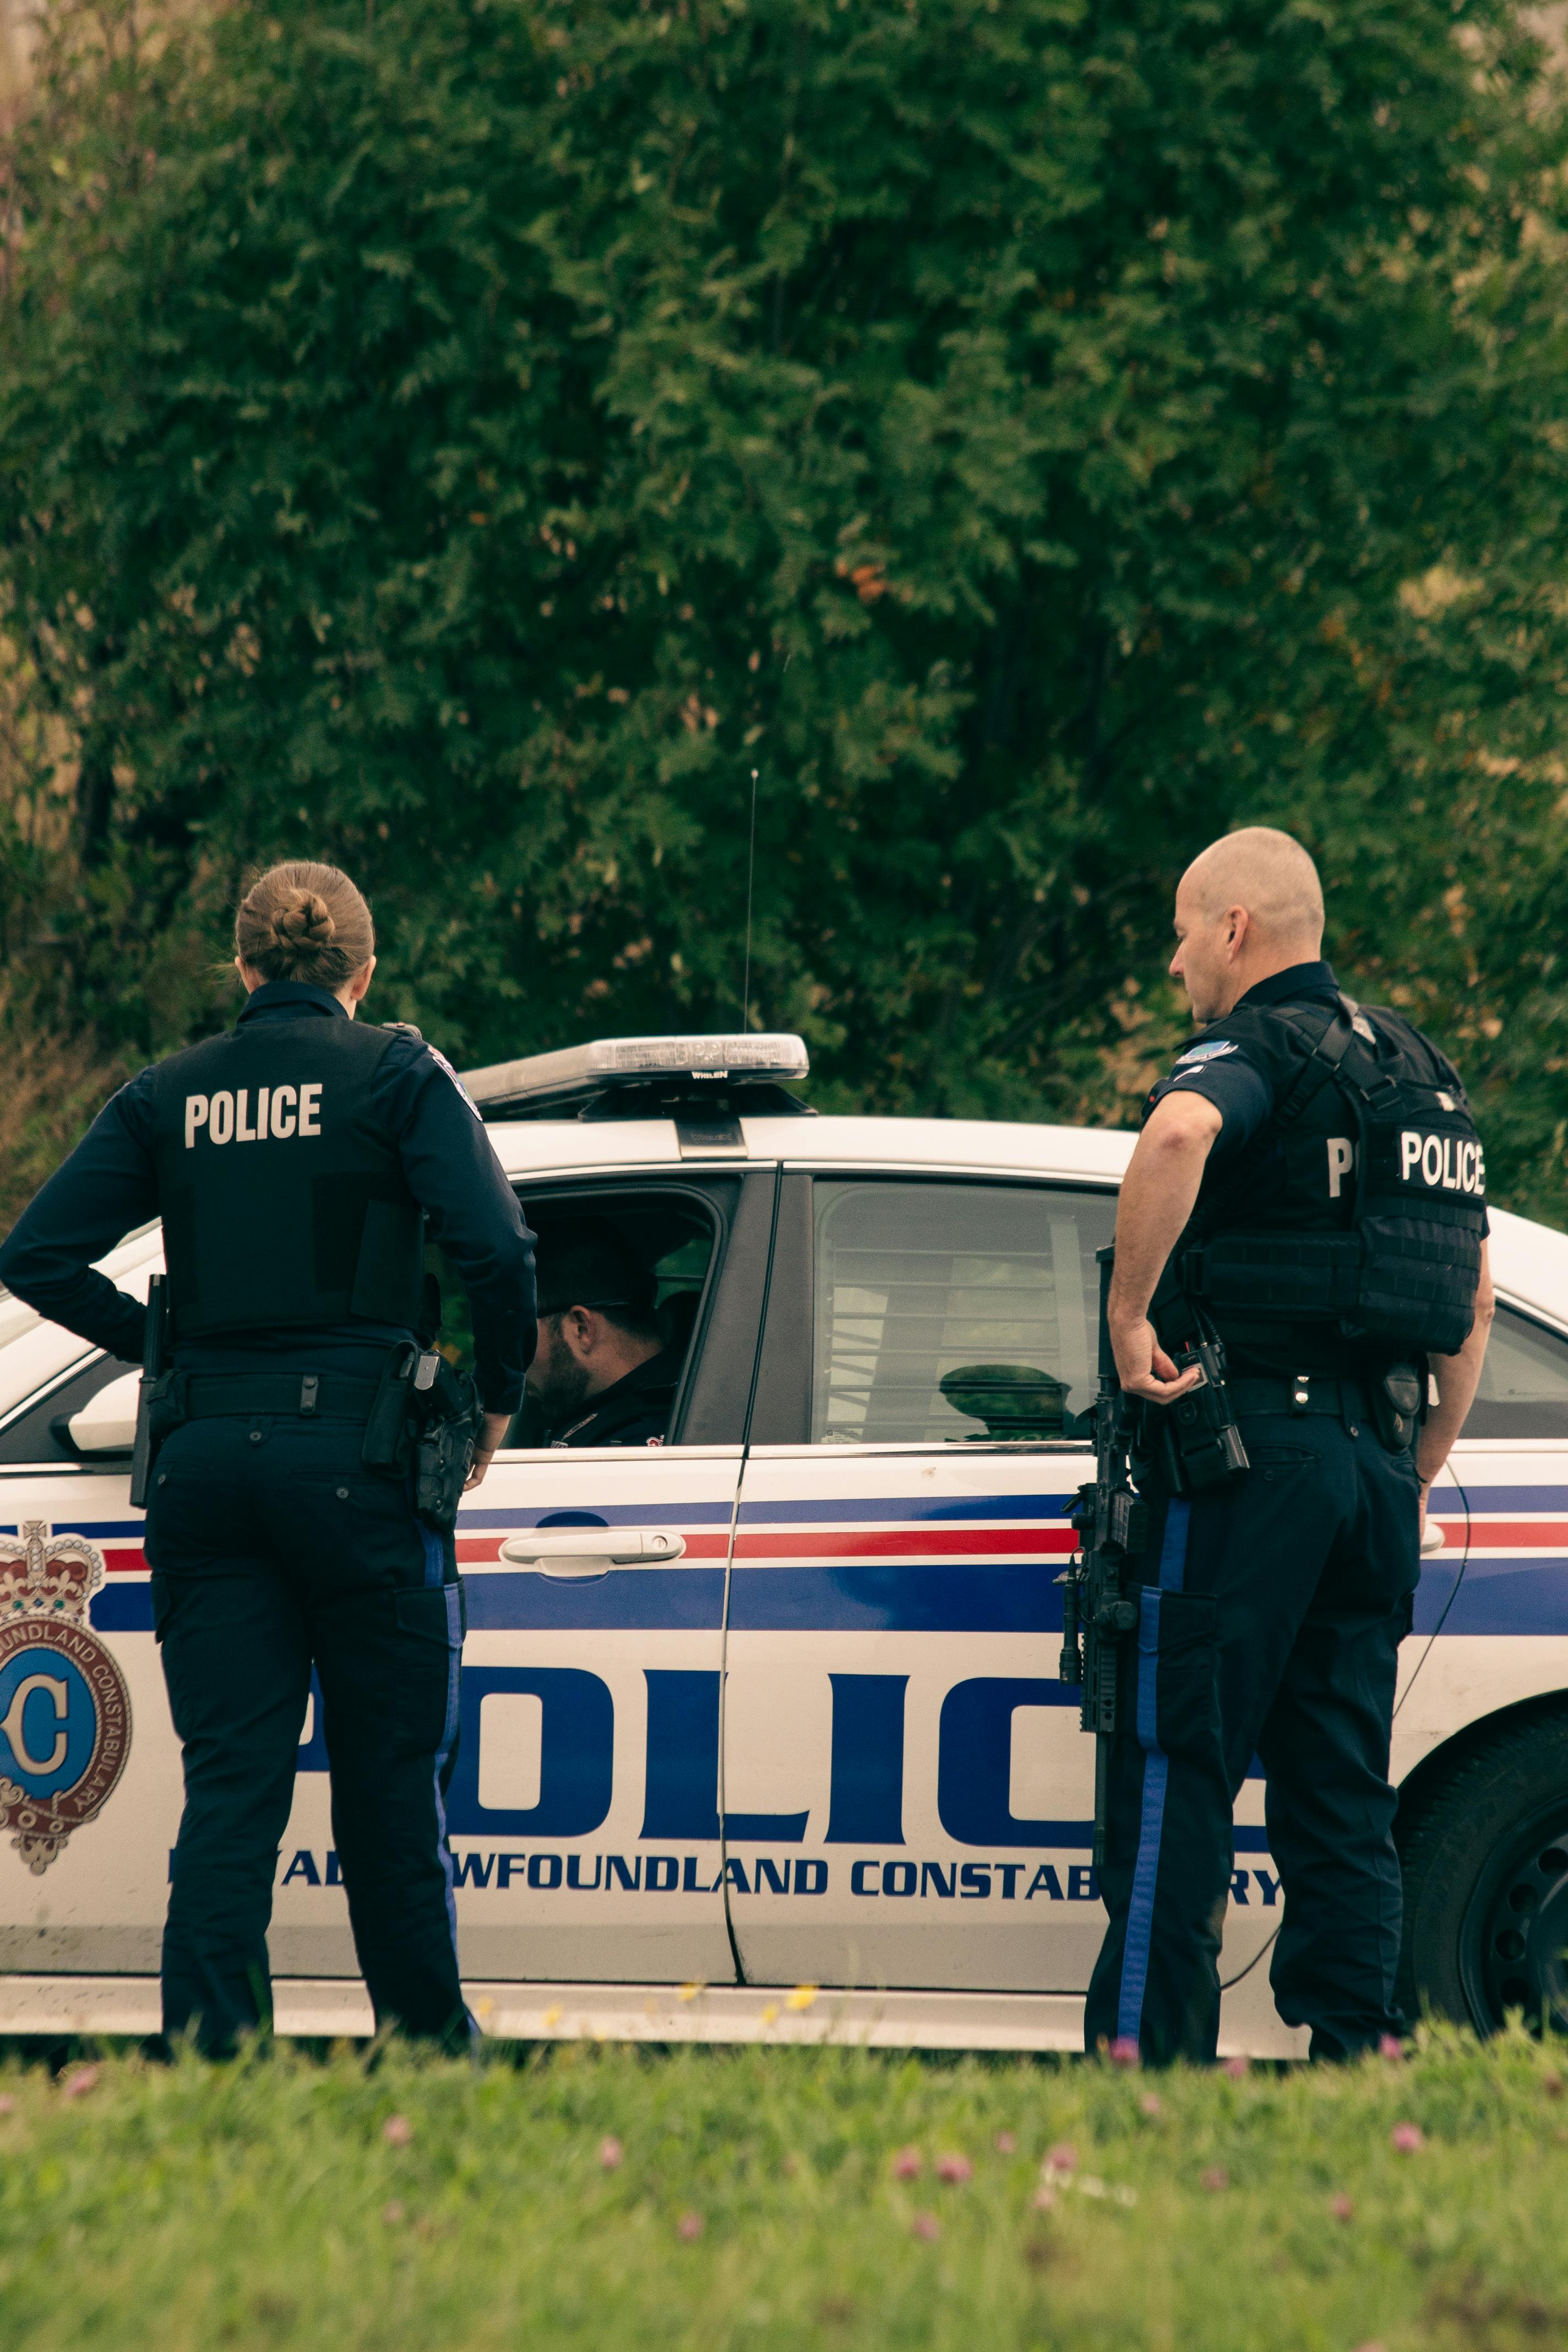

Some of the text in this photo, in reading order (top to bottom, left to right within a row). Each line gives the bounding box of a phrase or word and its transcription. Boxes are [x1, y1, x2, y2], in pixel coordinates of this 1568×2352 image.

[184, 1084, 323, 1149] POLICE
[1401, 1131, 1485, 1196] POLICE
[0, 1624, 122, 1813] UNDLAND CONSTABULARY
[450, 1853, 829, 1895] WFOUNDLAND
